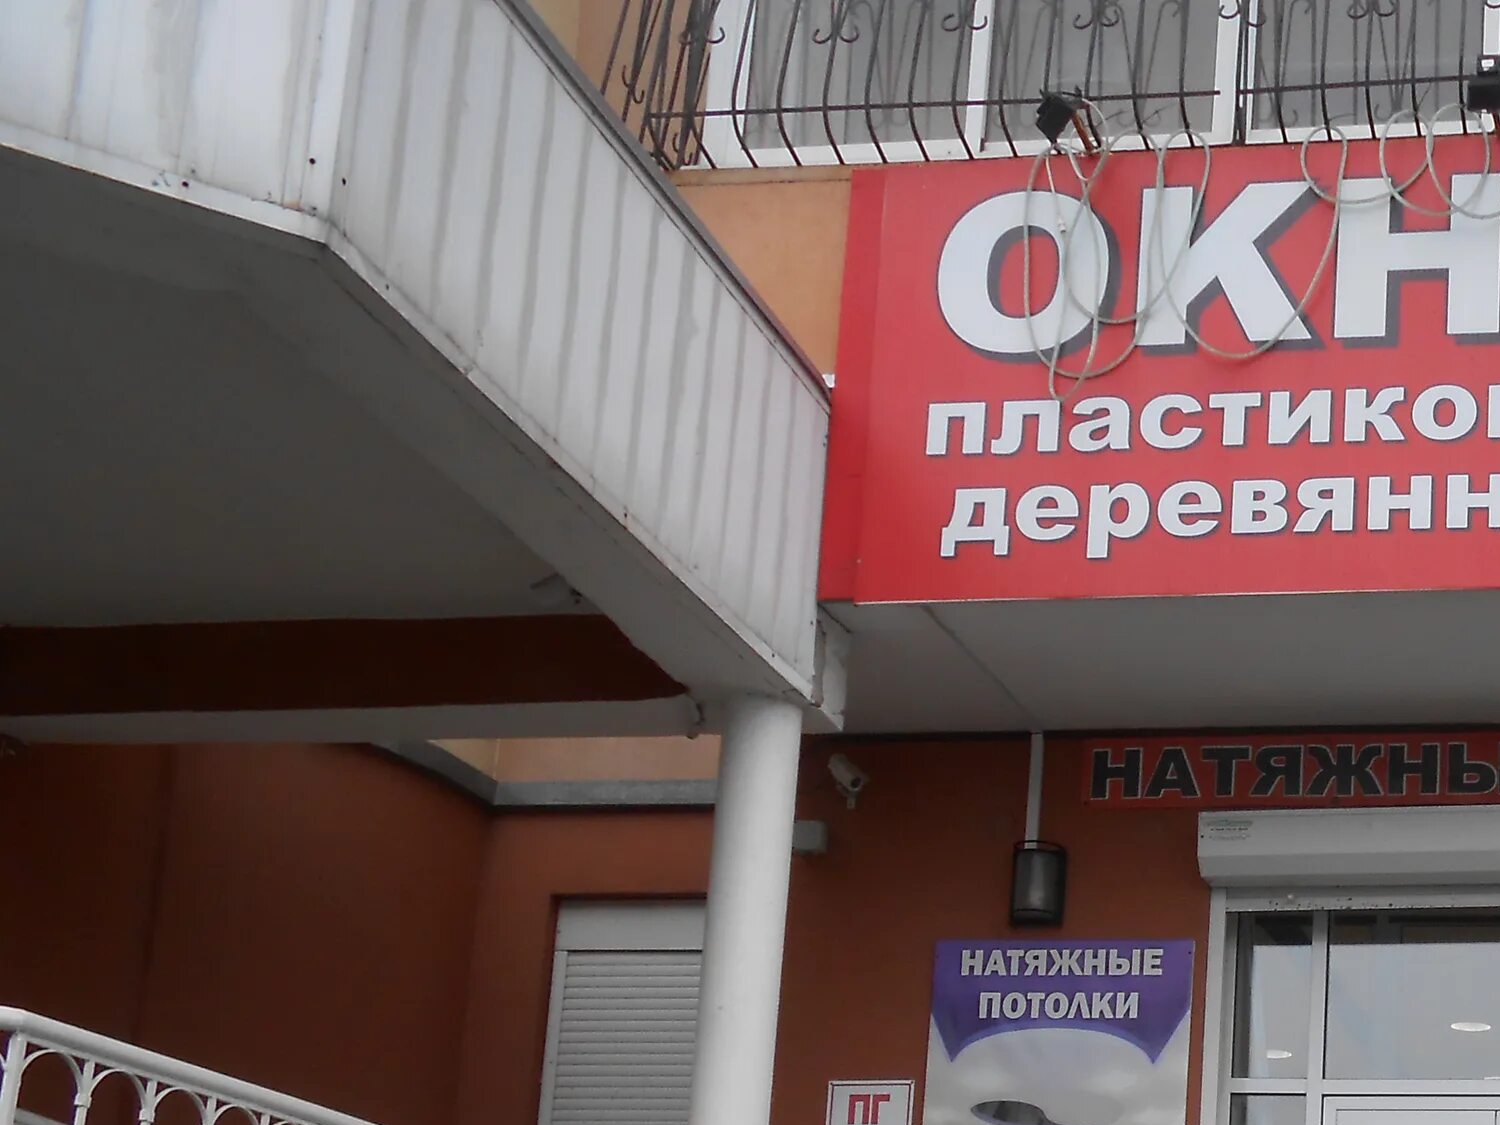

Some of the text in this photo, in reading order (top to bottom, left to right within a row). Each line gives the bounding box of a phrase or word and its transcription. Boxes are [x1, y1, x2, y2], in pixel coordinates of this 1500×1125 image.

[960, 948, 1164, 977] НАТЯЖНЫЕ
[978, 991, 1139, 1019] ПОТОЛКИ
[847, 1094, 891, 1125] ПГ
